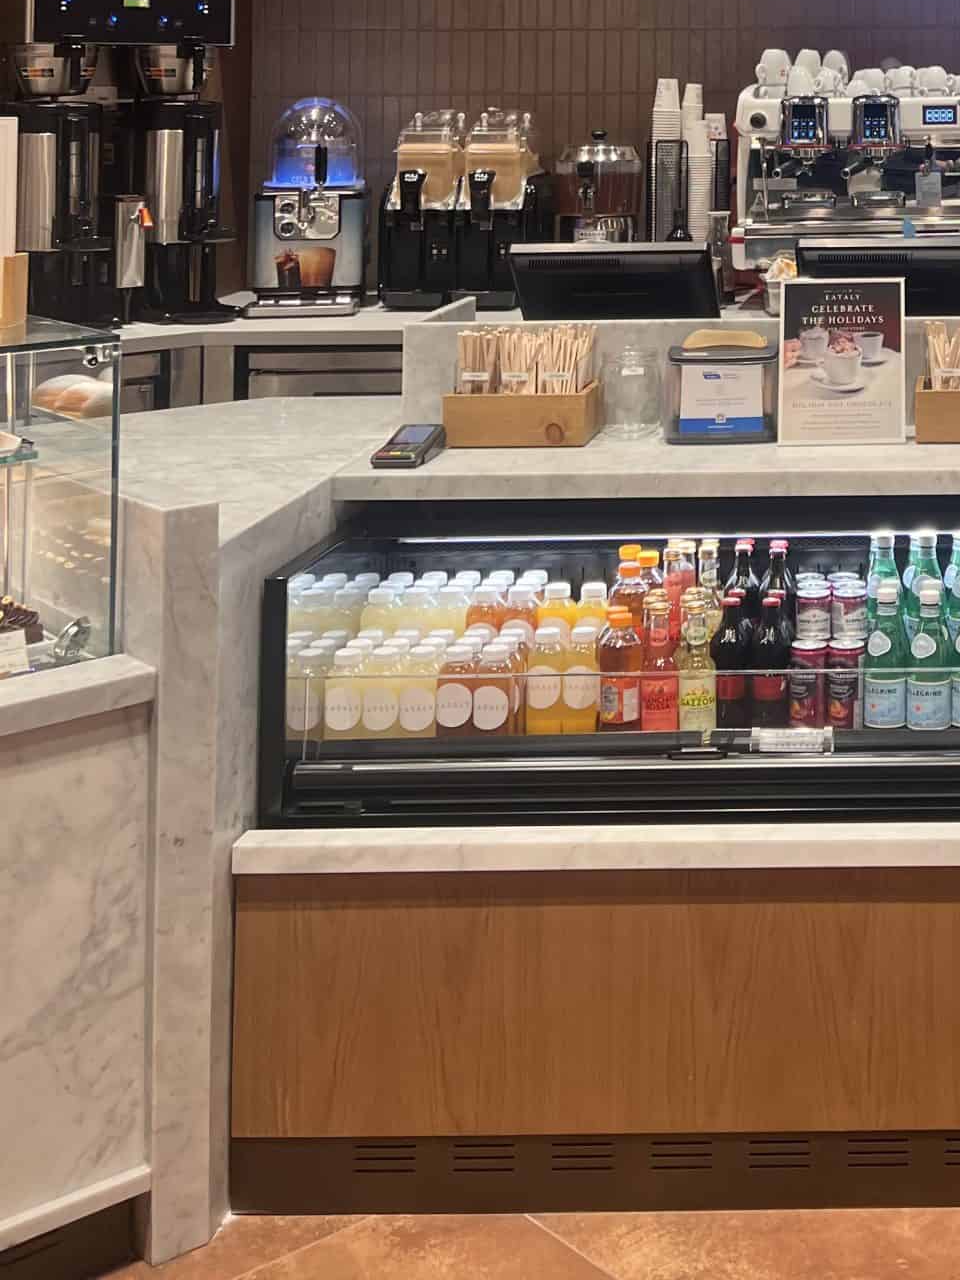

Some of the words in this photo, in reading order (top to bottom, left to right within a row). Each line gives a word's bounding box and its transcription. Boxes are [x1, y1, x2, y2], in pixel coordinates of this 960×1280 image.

[811, 304, 875, 313] CELEBRATE
[801, 316, 825, 325] THE
[828, 315, 885, 325] HOLIDAYS
